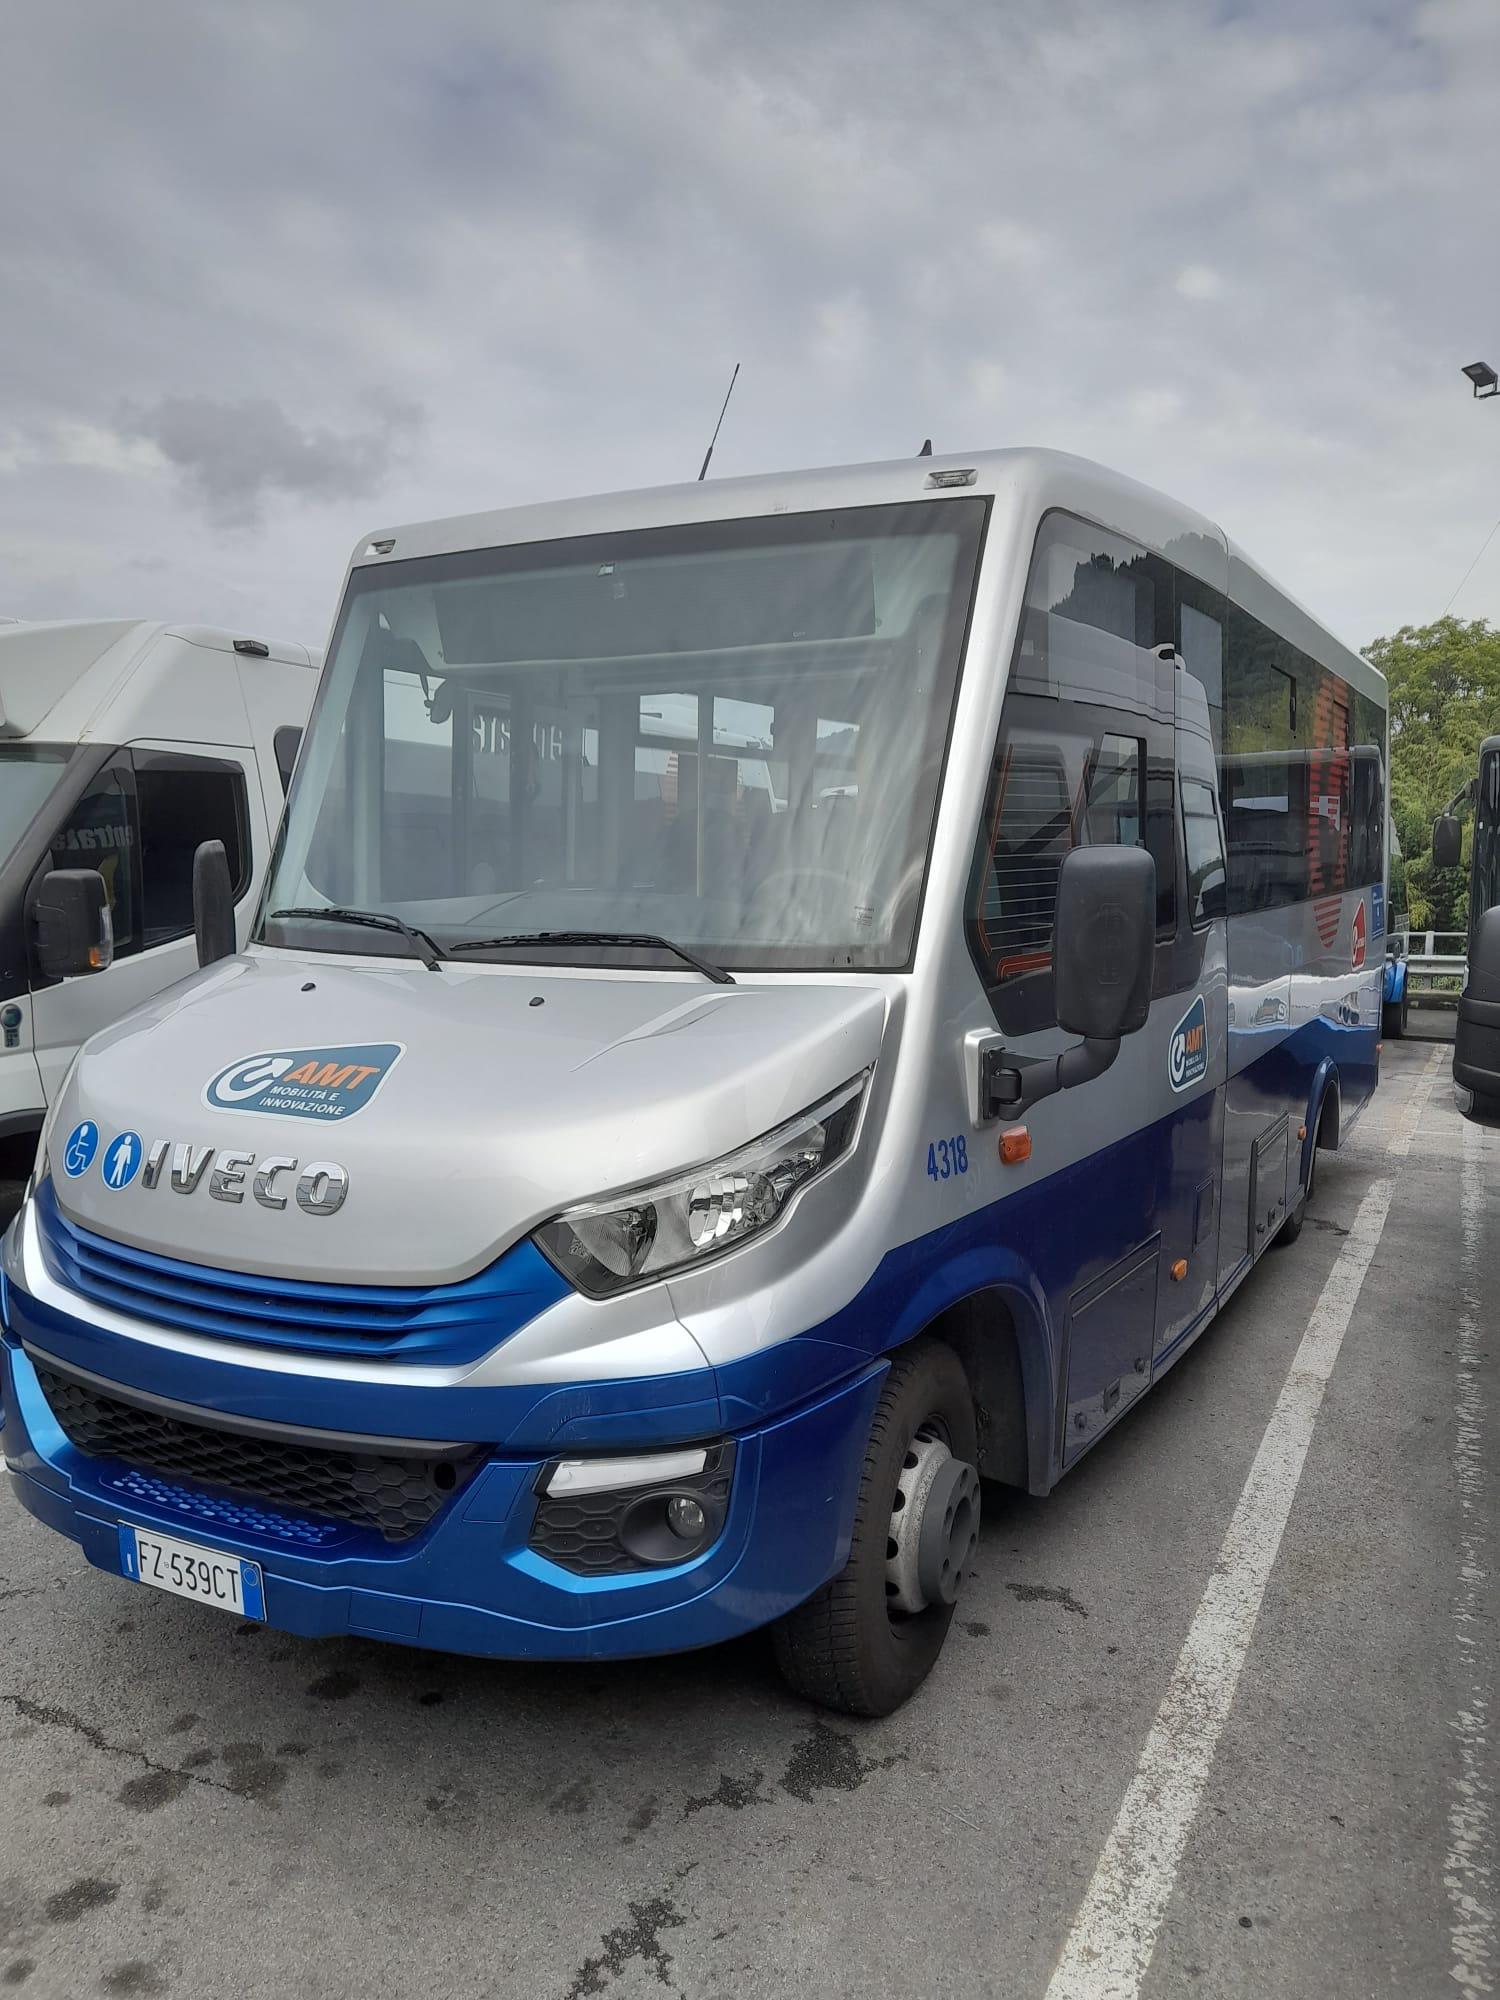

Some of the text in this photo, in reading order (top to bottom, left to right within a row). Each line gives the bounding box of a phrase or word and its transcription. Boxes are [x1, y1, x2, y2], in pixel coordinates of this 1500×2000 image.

[1186, 1024, 1204, 1055] AMT
[283, 1061, 380, 1090] AMT
[259, 1097, 346, 1115] INNOVAZIONE
[270, 1085, 340, 1101] MOBILITÀ E
[927, 1134, 969, 1182] 4318
[141, 1139, 350, 1217] IVECO
